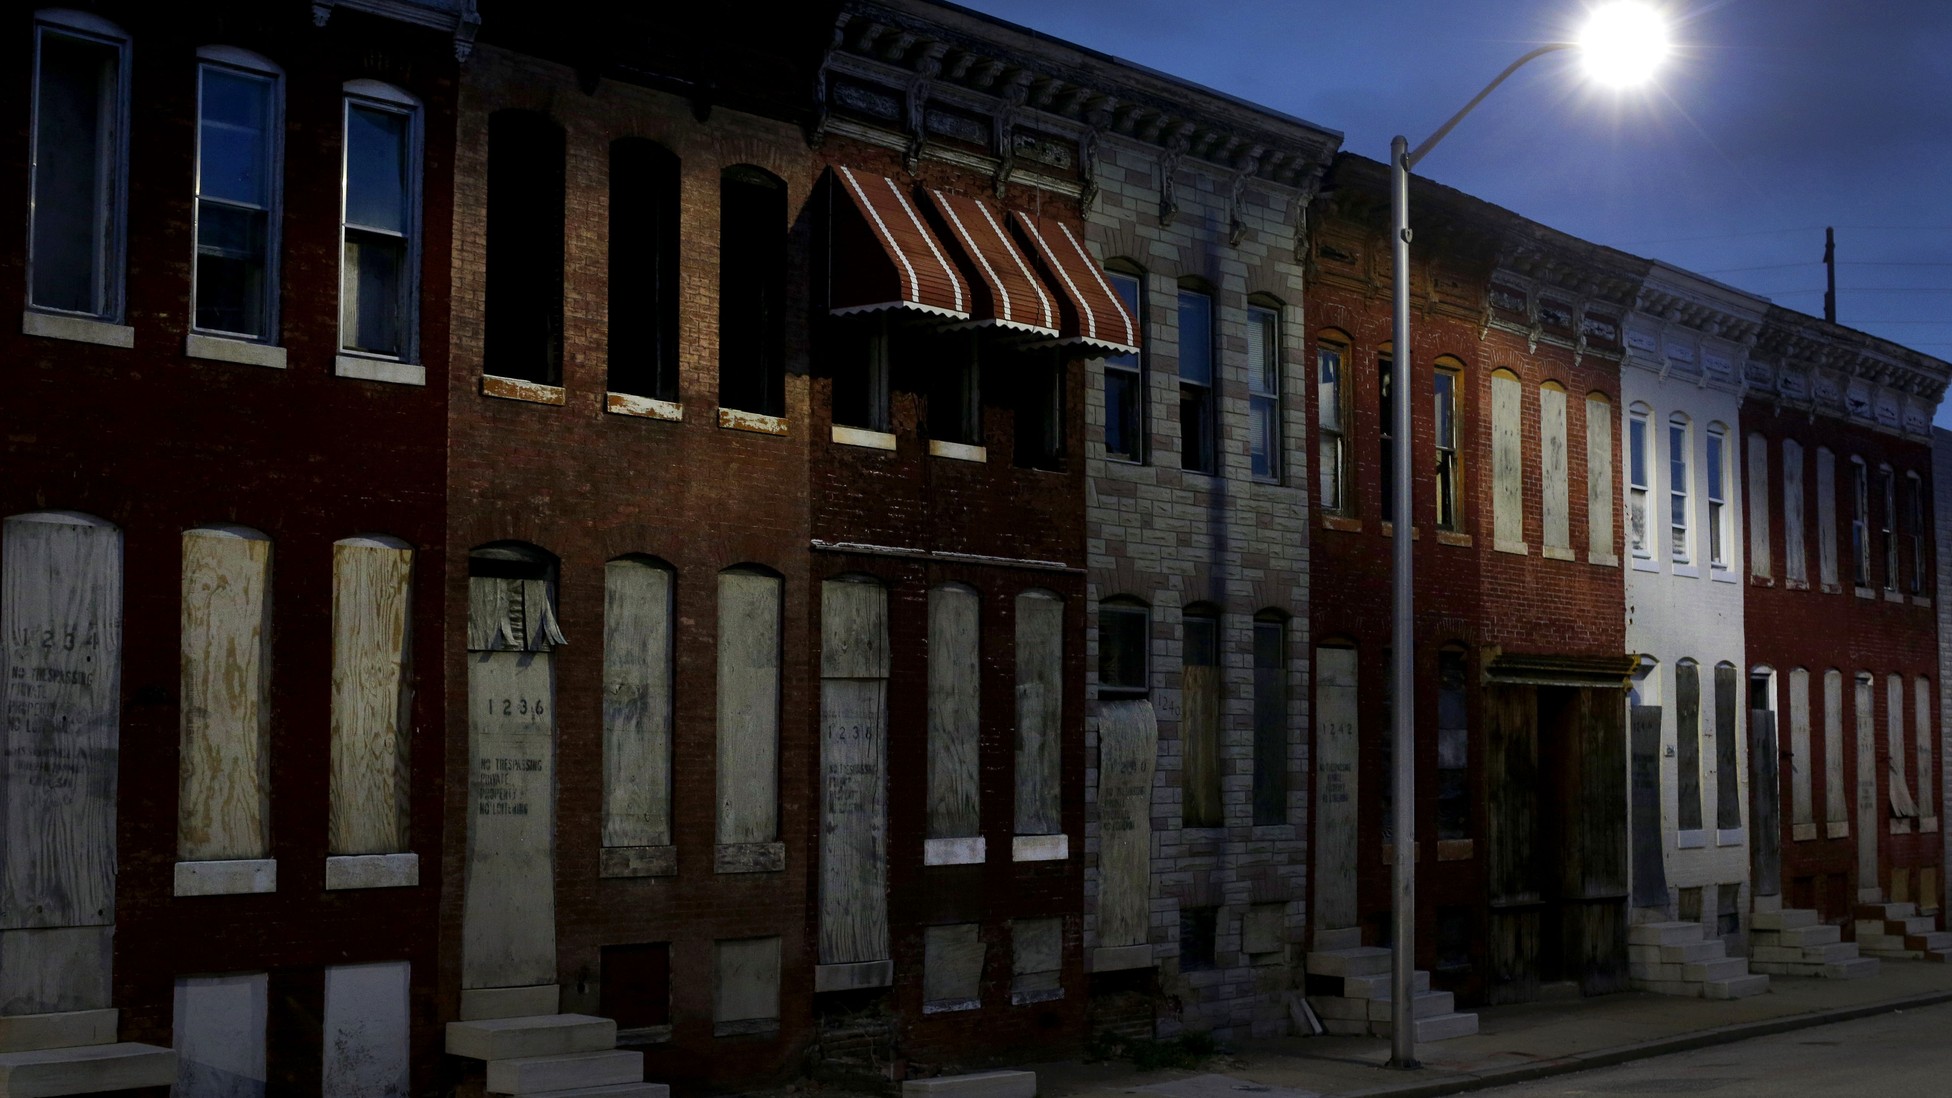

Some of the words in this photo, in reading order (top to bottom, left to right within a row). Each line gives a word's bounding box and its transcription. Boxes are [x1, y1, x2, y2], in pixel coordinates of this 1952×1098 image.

[23, 628, 98, 651] 1234
[11, 666, 25, 680] NO
[32, 667, 94, 687] TRESPASSING
[488, 698, 544, 716] 1236
[1158, 693, 1181, 716] 1240
[1322, 722, 1353, 736] 1242
[480, 758, 491, 771] NO
[495, 758, 543, 772] TRESPASSING
[480, 773, 509, 786] PRIVATE
[479, 802, 490, 815] NO
[492, 802, 529, 815] LOITERING
